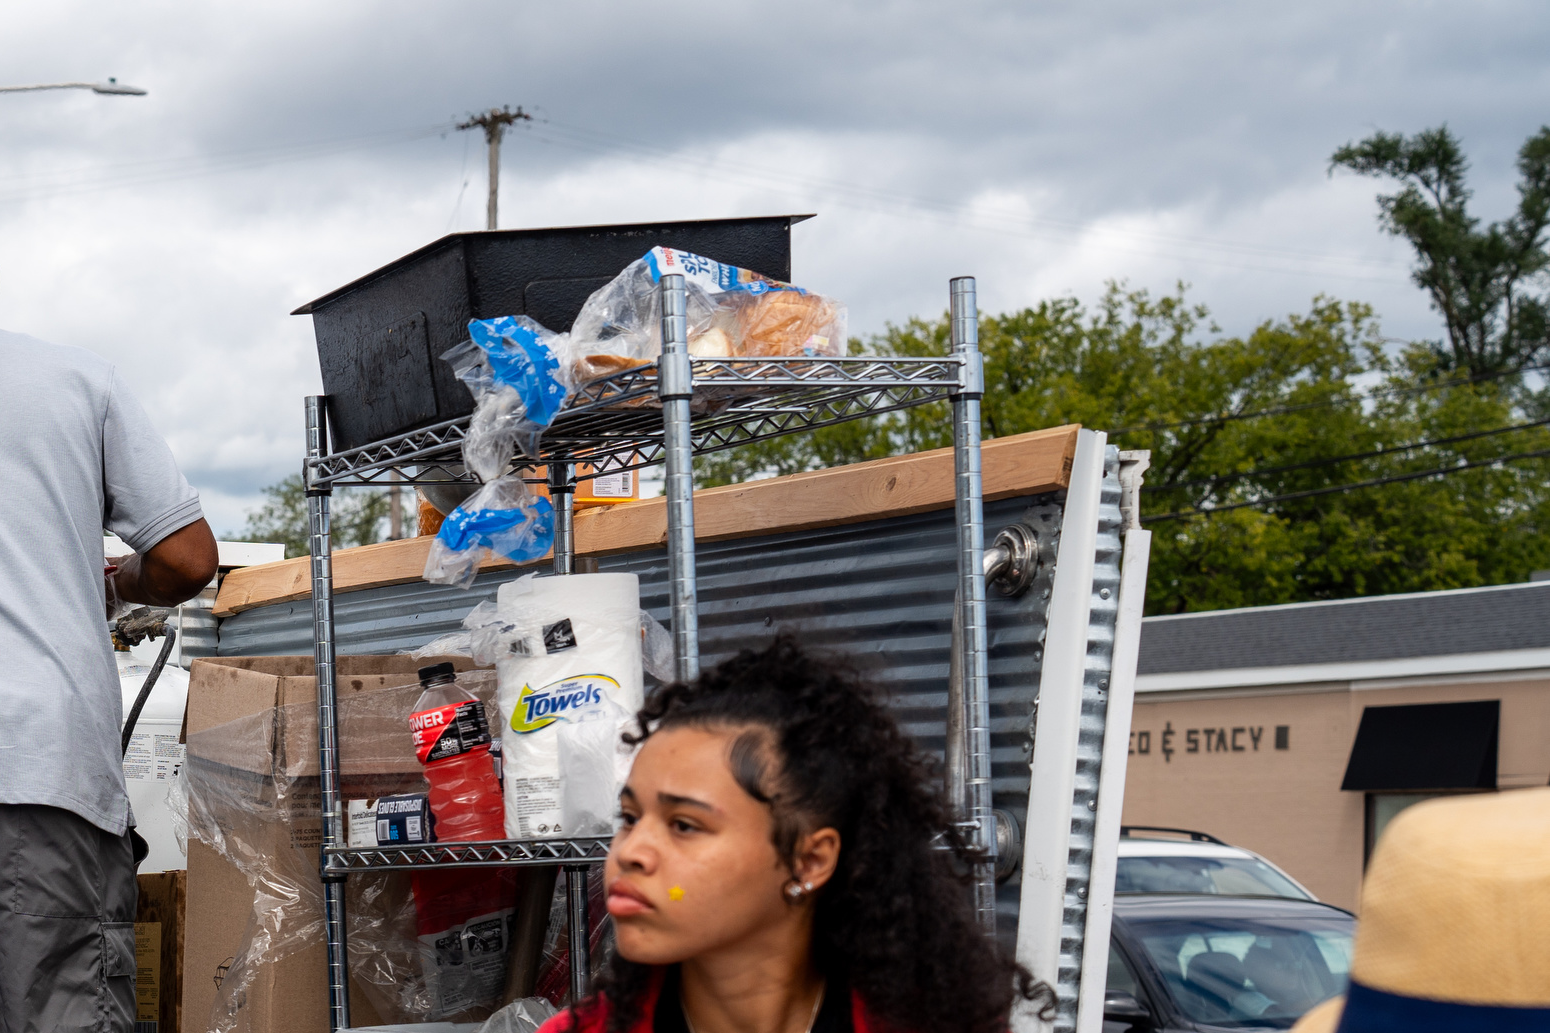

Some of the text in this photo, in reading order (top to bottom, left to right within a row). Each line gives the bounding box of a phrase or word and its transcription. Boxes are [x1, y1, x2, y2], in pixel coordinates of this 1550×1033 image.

[678, 252, 697, 276] SPL
[523, 684, 602, 722] Towels
[412, 730, 424, 746] DE
[1185, 726, 1263, 754] STACY
